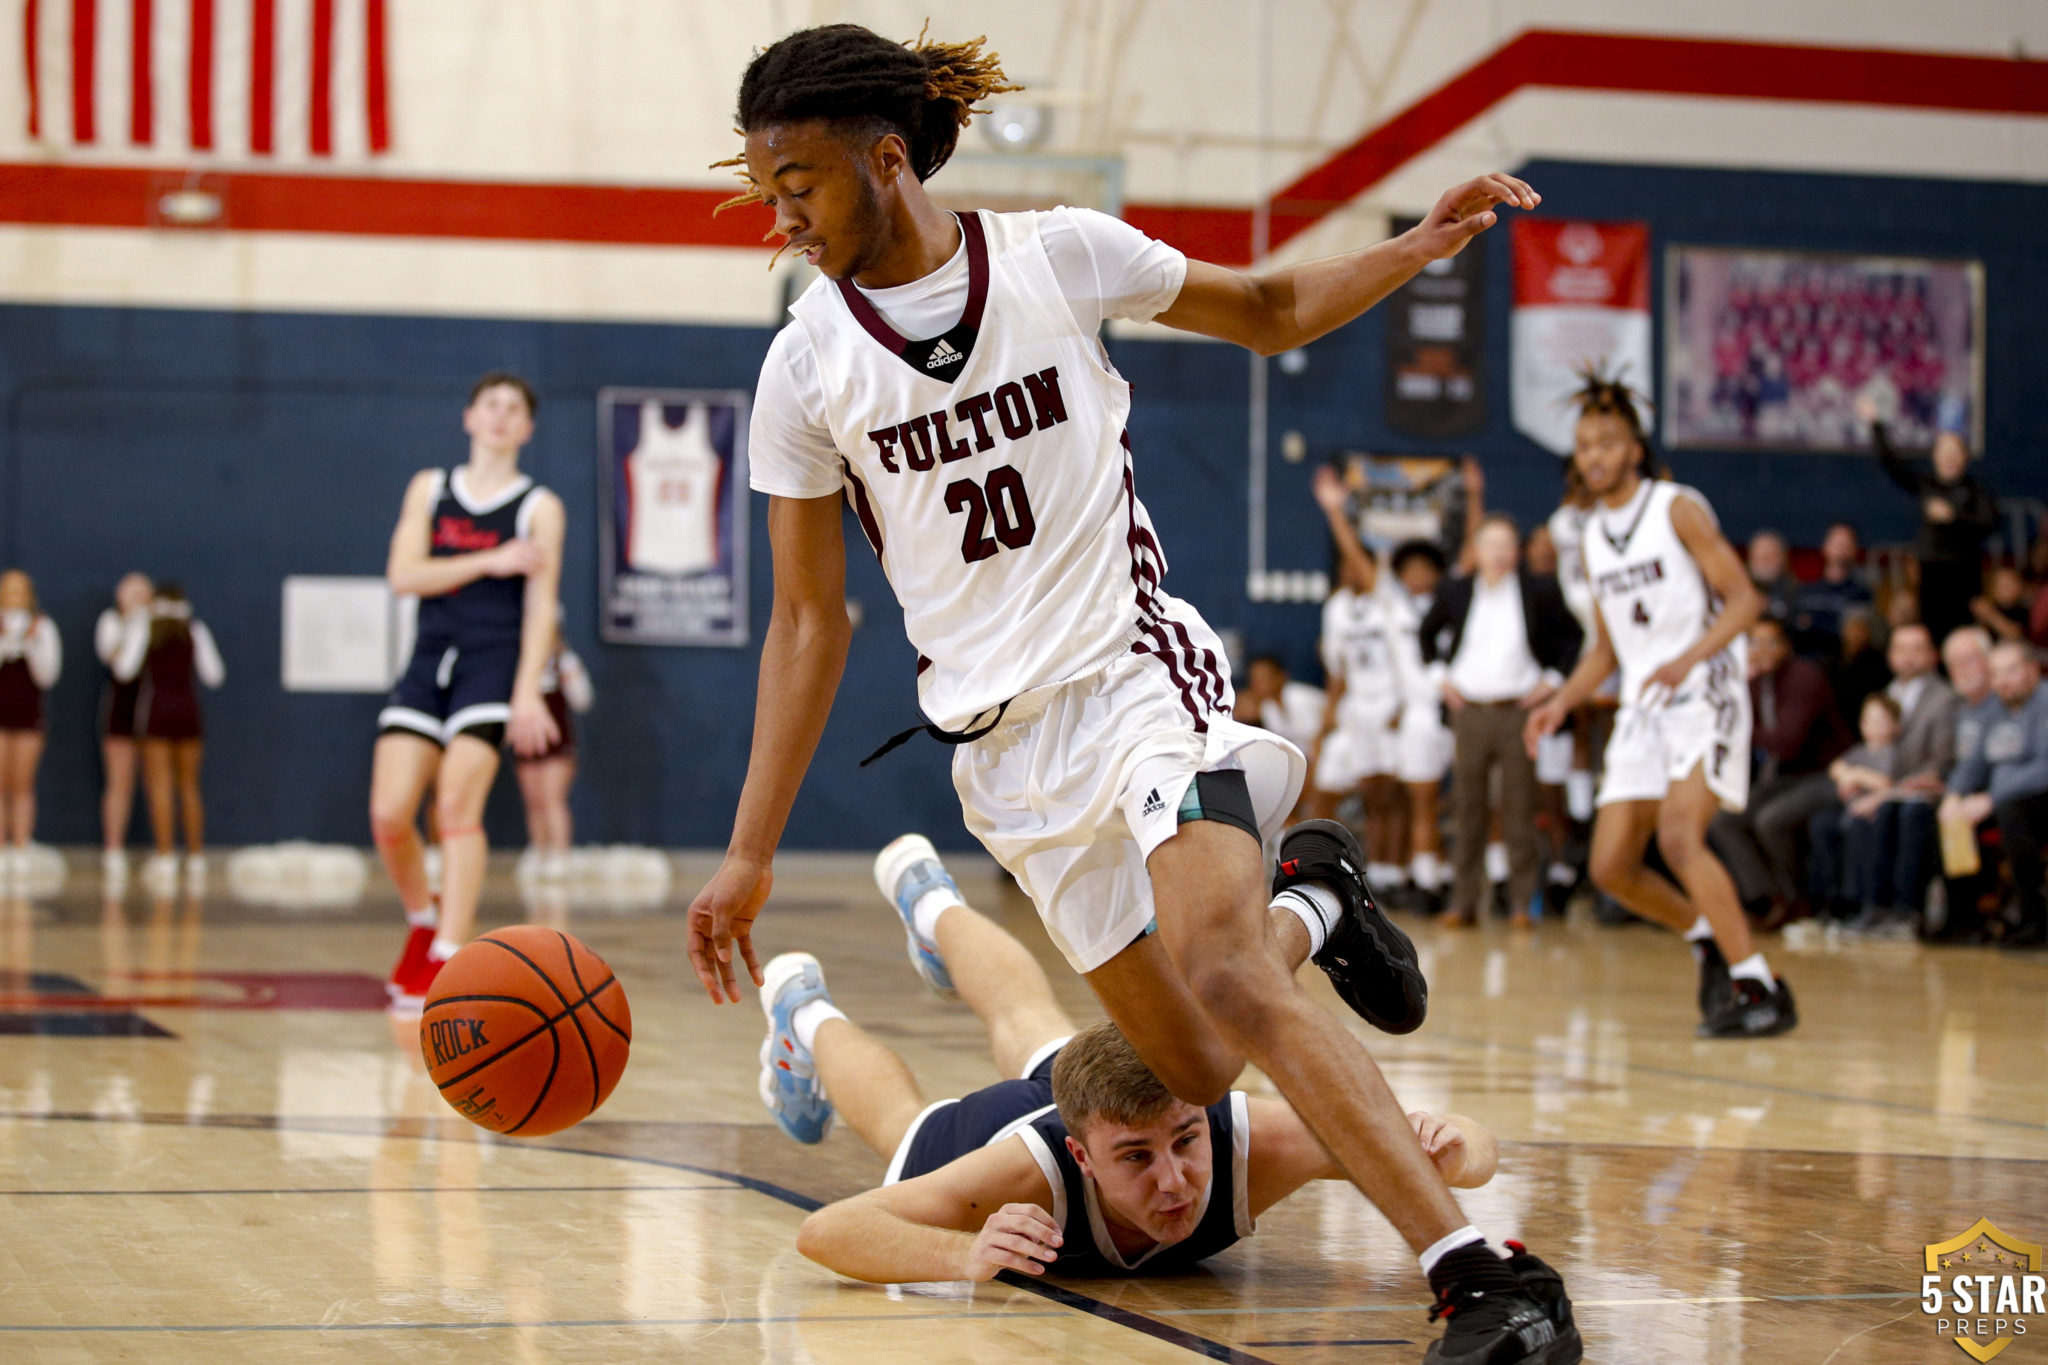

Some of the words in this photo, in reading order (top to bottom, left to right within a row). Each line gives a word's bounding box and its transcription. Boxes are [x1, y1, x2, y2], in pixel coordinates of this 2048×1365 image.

[926, 351, 963, 369] adidas
[867, 365, 1069, 474] FULTON
[943, 464, 1036, 564] 20
[1632, 599, 1651, 626] 4
[430, 1018, 490, 1067] ROCK
